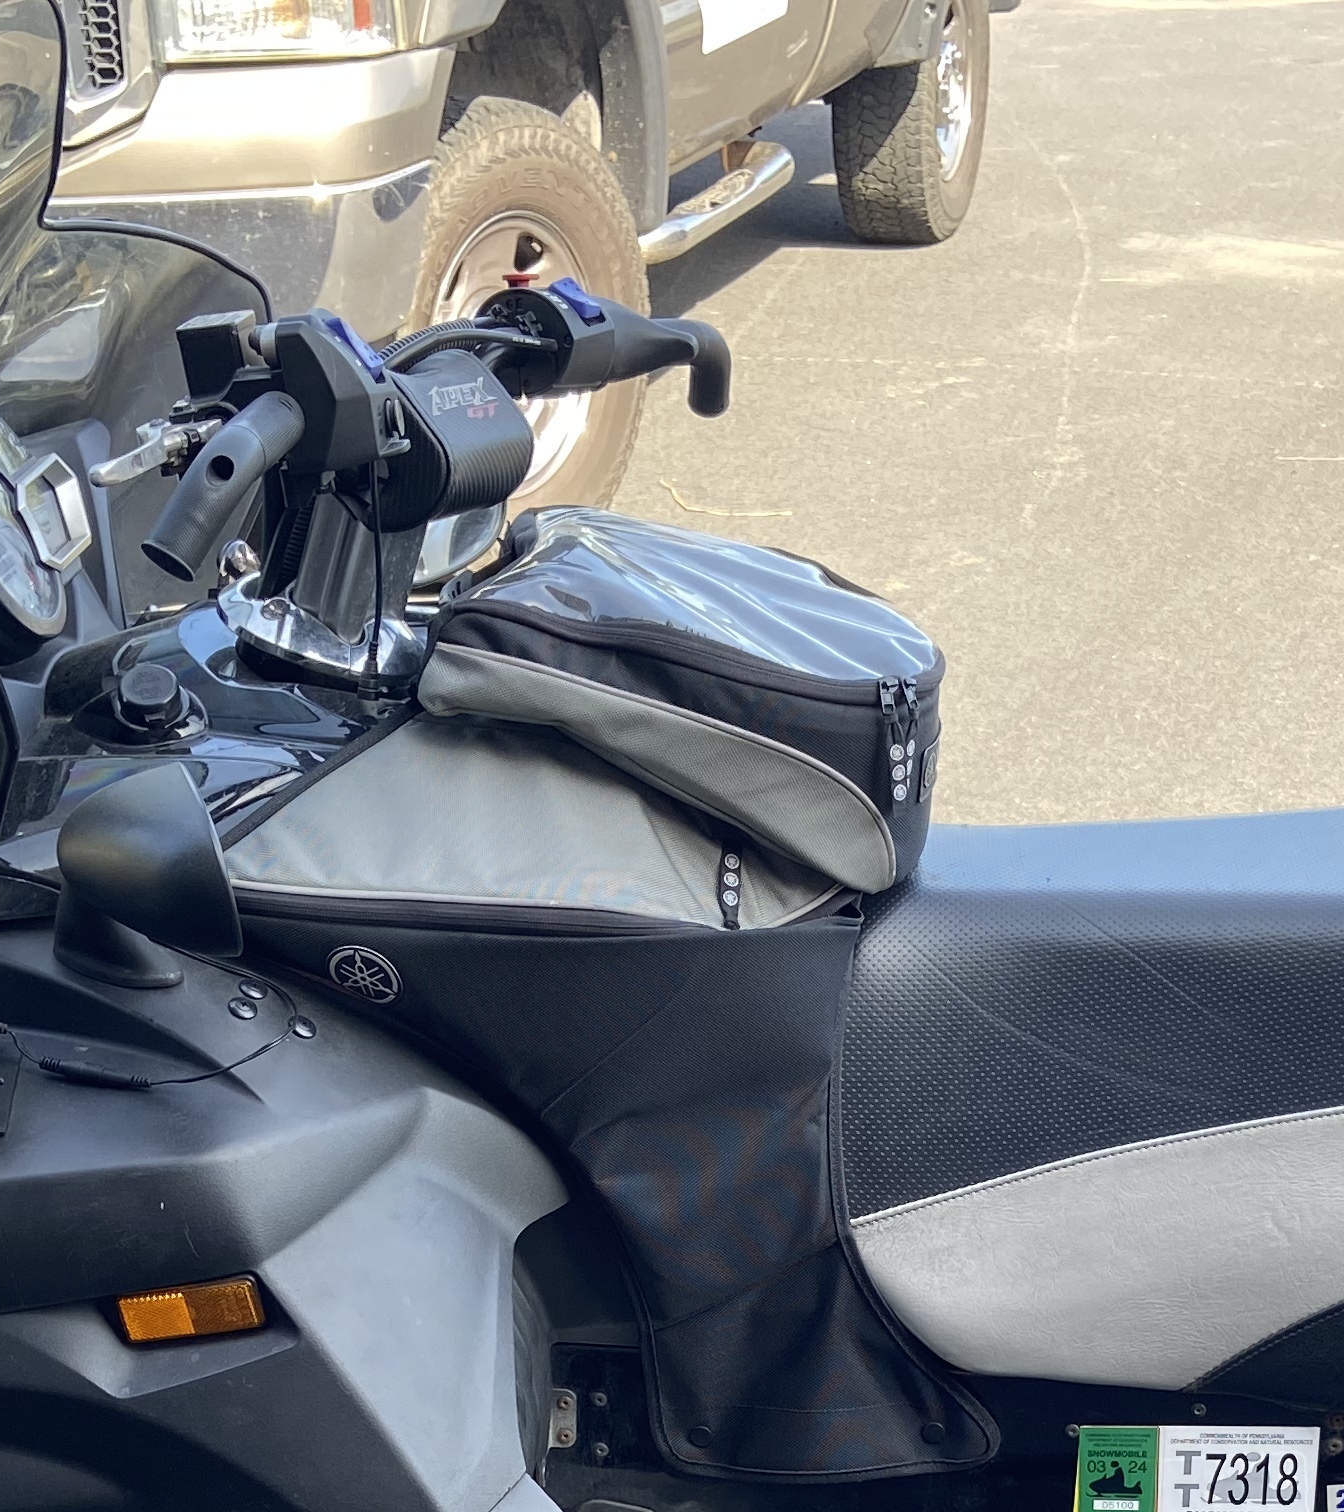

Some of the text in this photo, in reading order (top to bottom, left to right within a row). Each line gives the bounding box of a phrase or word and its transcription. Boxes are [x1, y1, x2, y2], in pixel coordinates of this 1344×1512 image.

[428, 376, 498, 416] APEX
[467, 401, 499, 419] GT
[1087, 1450, 1147, 1458] SNOWMOBILE
[1087, 1460, 1107, 1473] 03
[1128, 1461, 1148, 1474] 24
[1206, 1453, 1298, 1505] 7318
